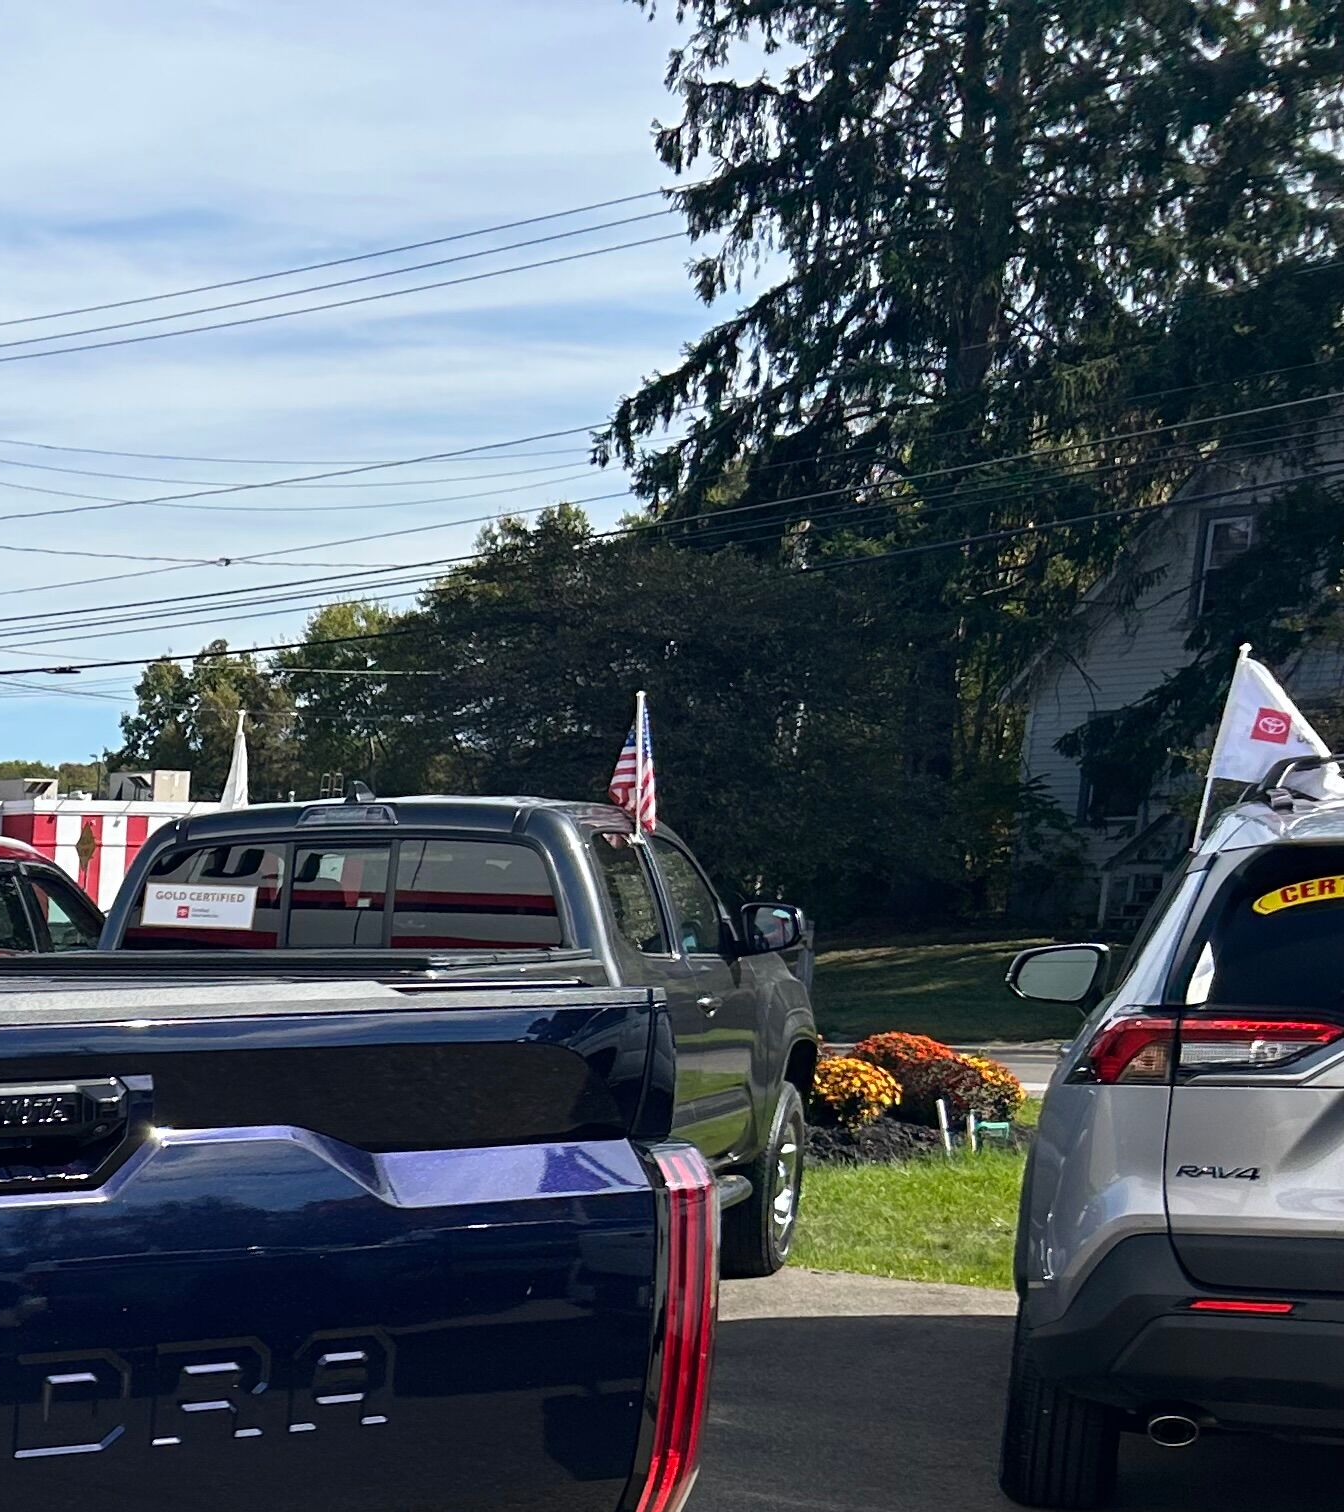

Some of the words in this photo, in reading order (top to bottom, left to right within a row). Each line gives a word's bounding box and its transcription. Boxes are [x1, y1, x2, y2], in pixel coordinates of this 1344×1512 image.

[156, 890, 187, 901] GOLD
[190, 892, 245, 904] CERTIFIED
[1280, 878, 1344, 903] CER
[1176, 1165, 1260, 1181] RAV4
